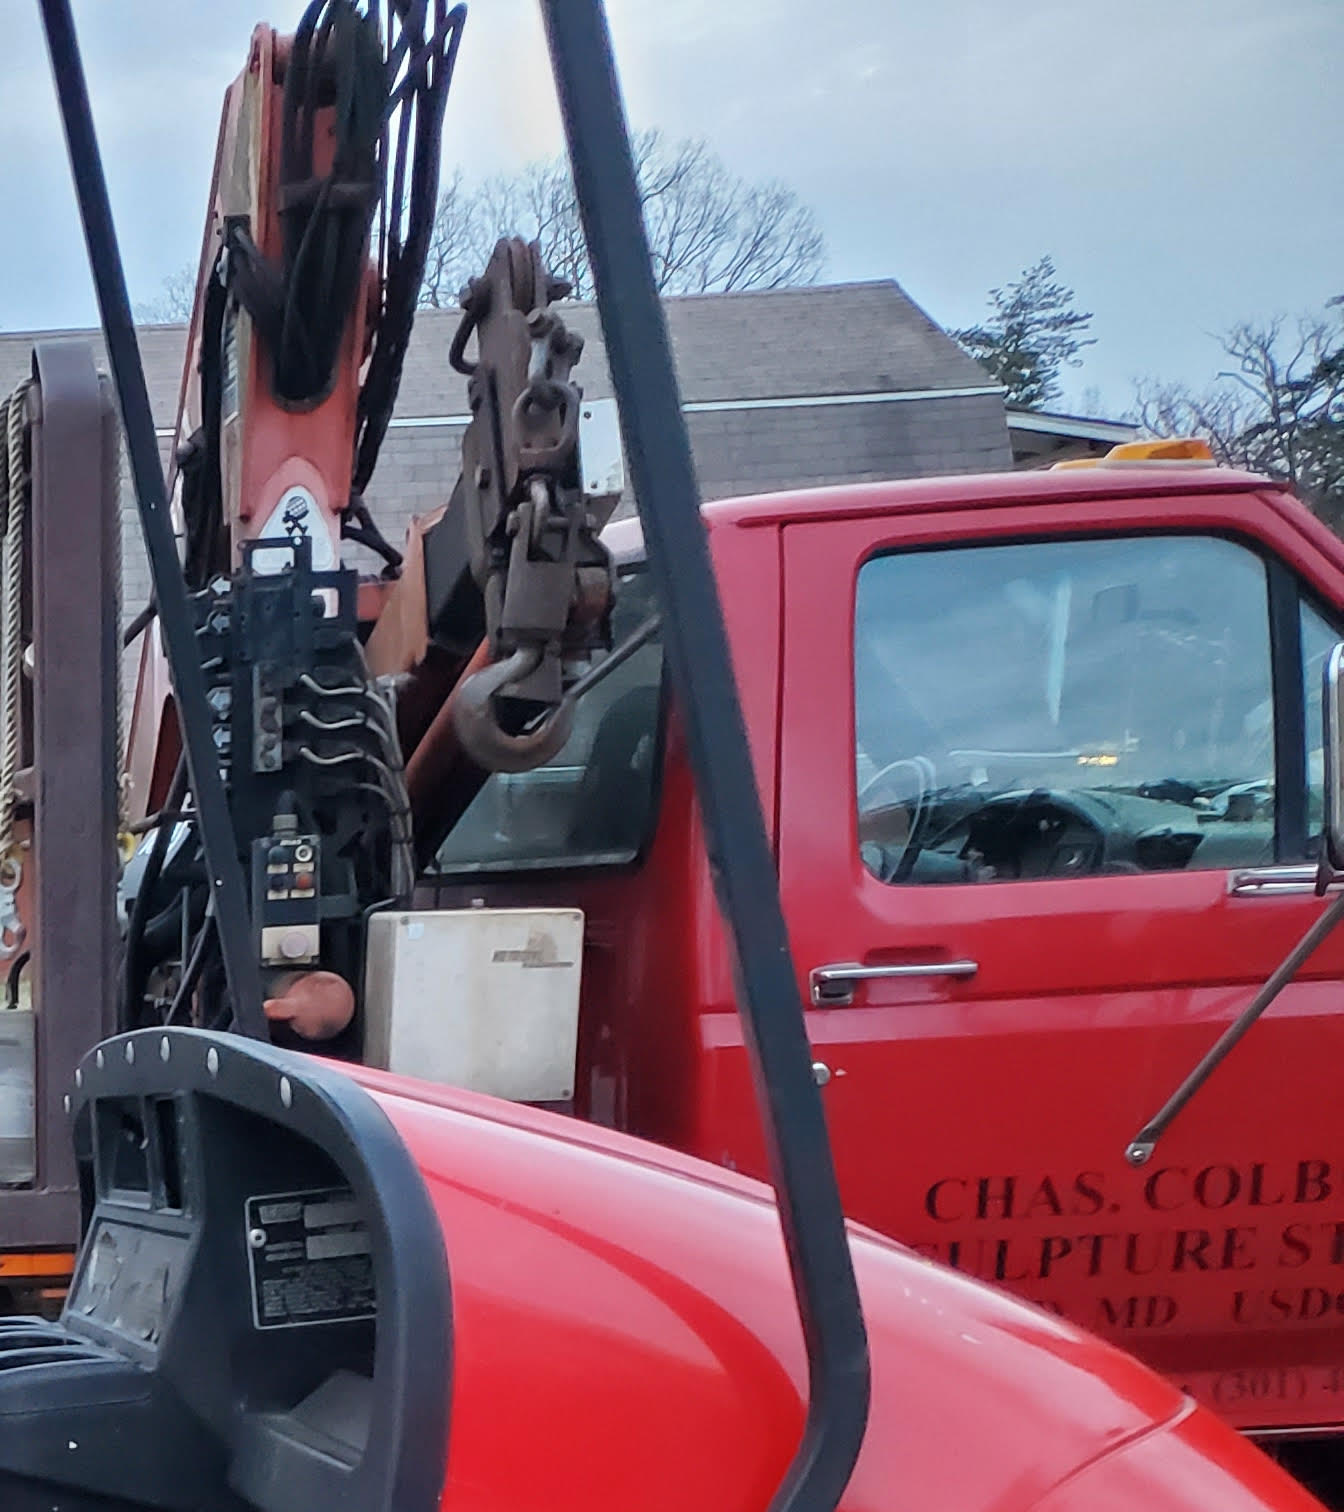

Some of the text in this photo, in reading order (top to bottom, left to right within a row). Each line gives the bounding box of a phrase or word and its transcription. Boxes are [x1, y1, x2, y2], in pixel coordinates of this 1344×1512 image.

[925, 1158, 1344, 1223] CHAS. COLB
[1099, 1295, 1179, 1329] MD
[1232, 1287, 1344, 1323] USD
